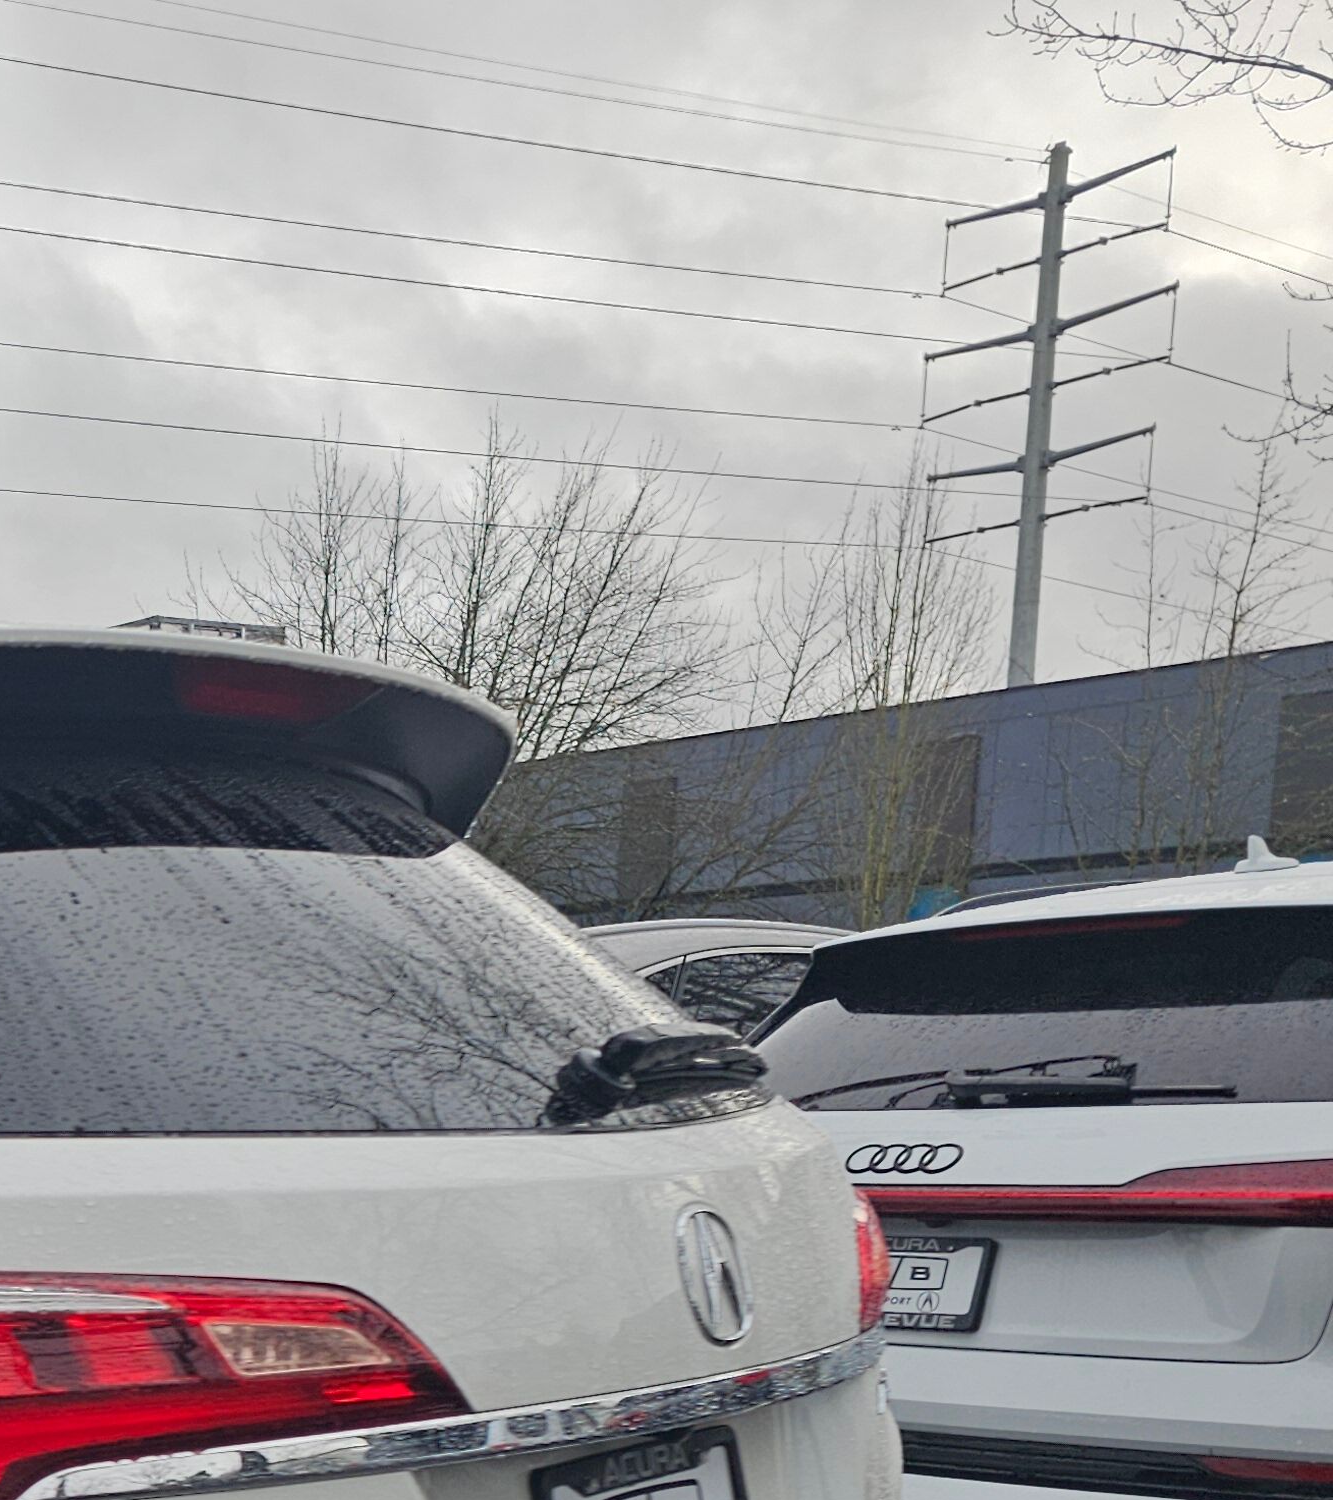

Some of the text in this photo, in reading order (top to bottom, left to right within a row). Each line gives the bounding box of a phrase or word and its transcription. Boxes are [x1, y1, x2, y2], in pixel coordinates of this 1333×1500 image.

[910, 1266, 930, 1280] B
[884, 1314, 957, 1329] EVUE
[603, 1442, 689, 1484] ACURA
